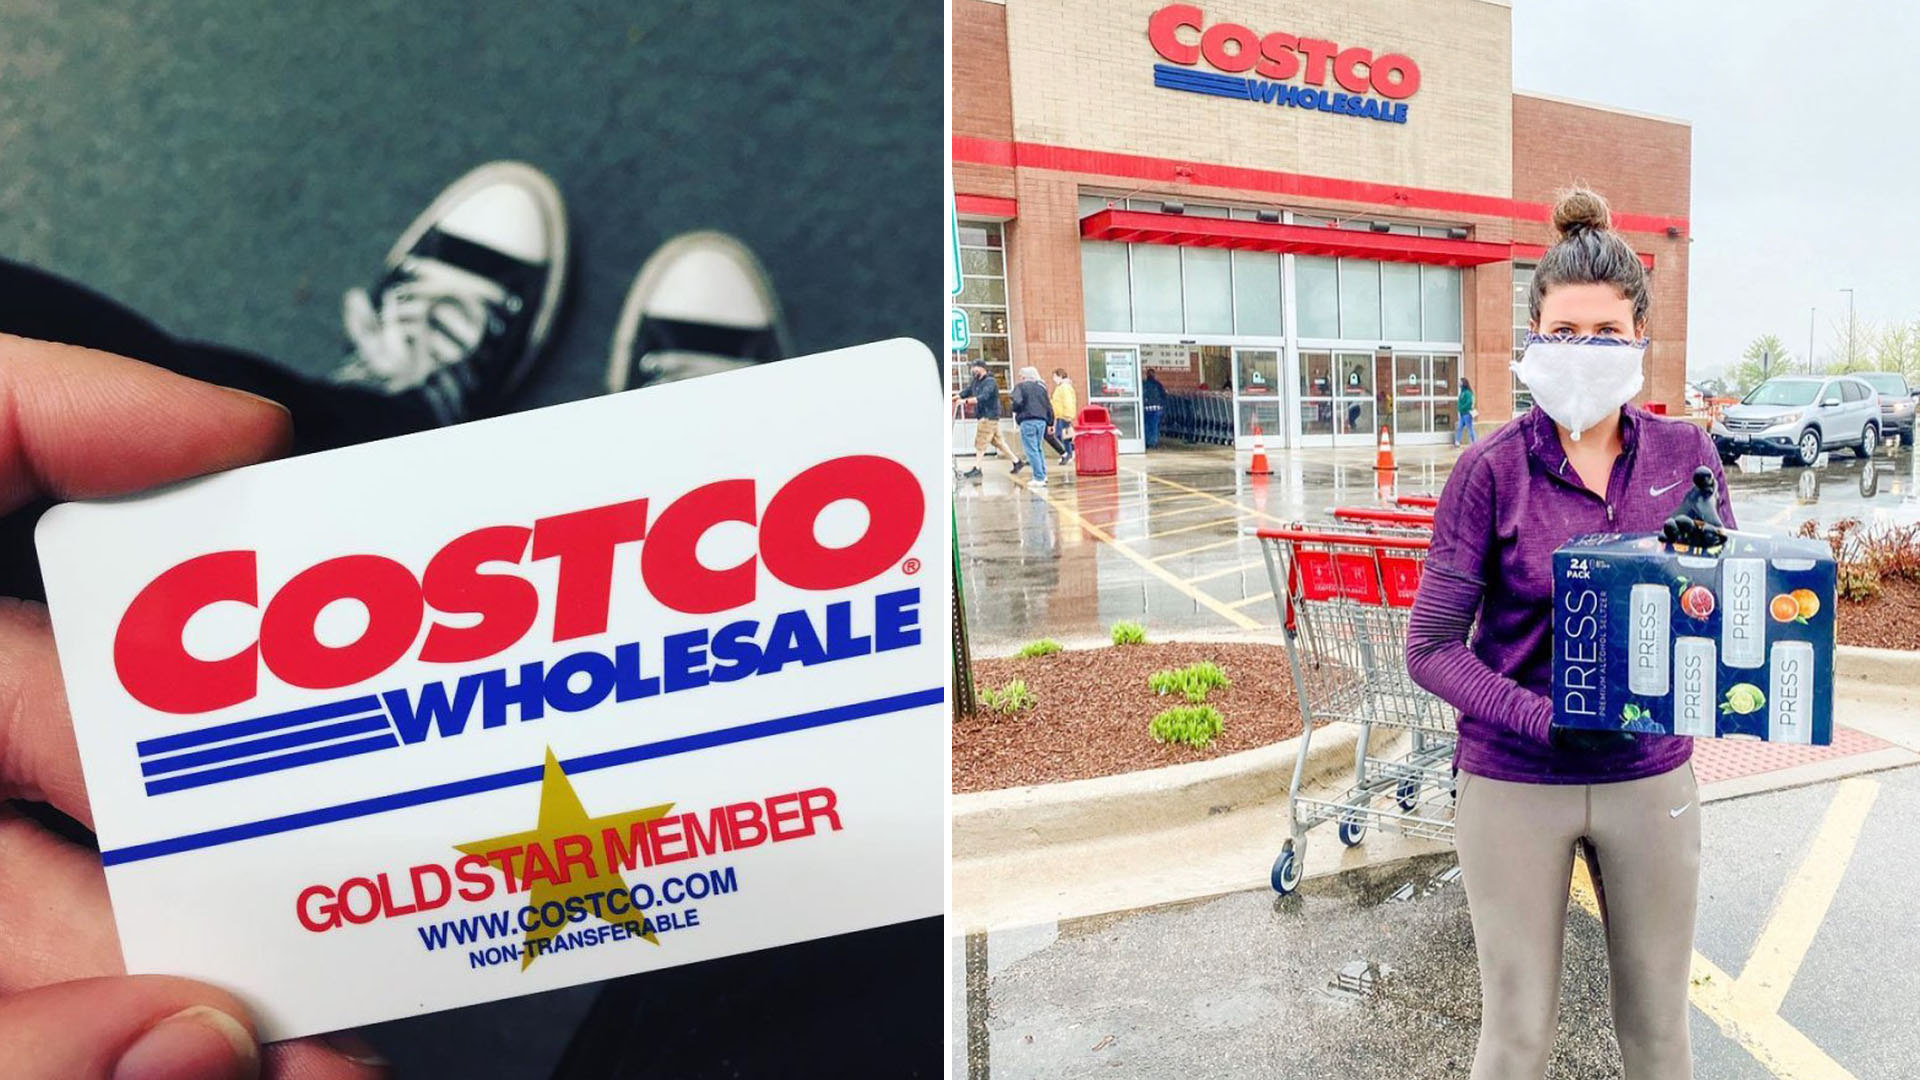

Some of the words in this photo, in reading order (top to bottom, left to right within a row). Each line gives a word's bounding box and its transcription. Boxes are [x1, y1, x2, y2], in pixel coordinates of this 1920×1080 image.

[1148, 3, 1421, 99] COSTCO
[1247, 79, 1409, 124] WHOLESALE
[114, 455, 925, 714] COSTCO
[1566, 570, 1591, 579] PACK
[1570, 558, 1588, 570] 24
[1600, 590, 1608, 629] SELTZER
[1639, 601, 1656, 669] PRESS
[1733, 570, 1750, 639] PRESS
[381, 587, 922, 745] WHOLESALE
[1565, 590, 1598, 715] PRESS
[1599, 633, 1607, 673] ALCOHOL
[1598, 676, 1607, 717] PREMIUM
[1684, 655, 1701, 720] PRESS
[1780, 658, 1798, 726] PRESS
[296, 834, 452, 933] GOLD
[455, 834, 597, 902] STAR
[600, 788, 843, 875] MEMBER
[418, 867, 738, 951] WWW.COSTCO.COM
[469, 909, 700, 969] NON-TRANSFERABLE
